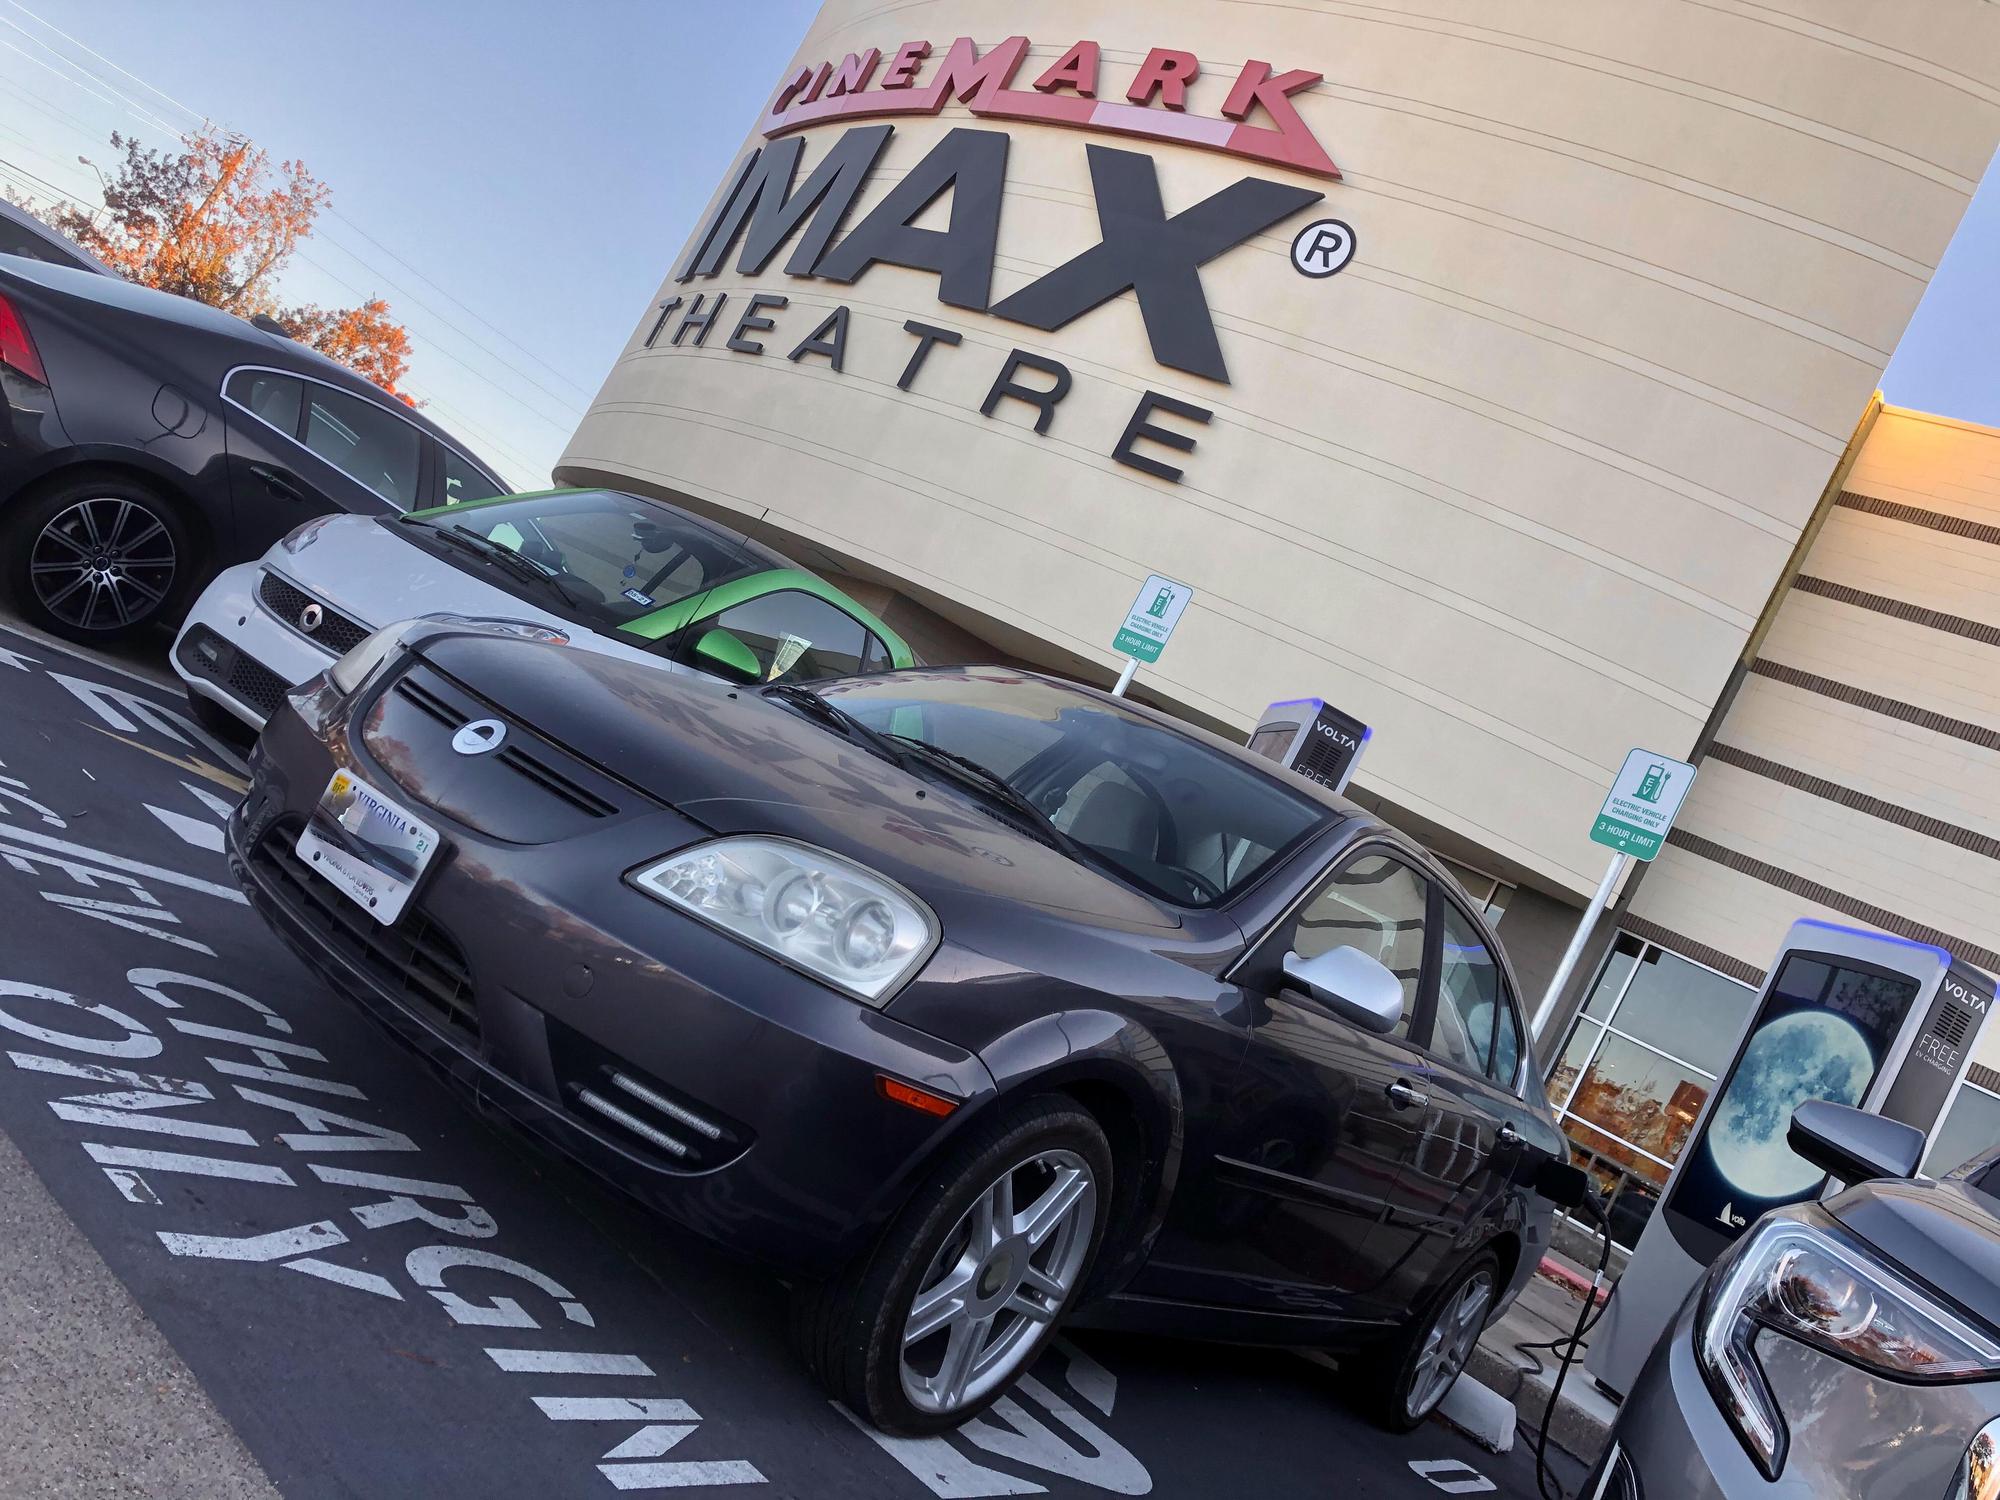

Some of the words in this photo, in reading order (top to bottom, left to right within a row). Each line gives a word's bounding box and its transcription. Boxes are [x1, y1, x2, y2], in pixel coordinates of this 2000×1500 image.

[761, 35, 1343, 180] CINEMARK
[675, 124, 1326, 385] IMAX
[644, 293, 1215, 485] THEATRE
[1154, 598, 1163, 612] EV
[1130, 622, 1152, 634] CHARGING
[1152, 630, 1163, 638] ONLY
[1131, 614, 1152, 627] ELECTRIC
[1152, 622, 1168, 633] VEHICLE
[1119, 633, 1125, 641] 3
[1125, 637, 1141, 646] HOUR
[1141, 642, 1158, 653] LIMIT
[1316, 720, 1356, 751] VOLTA
[1642, 777, 1655, 795] EV
[358, 791, 407, 834] VIRGINIA
[1612, 797, 1642, 813] ELECTRIC
[1642, 808, 1667, 821] VEHICLE
[1612, 806, 1643, 823] CHARGING
[1644, 818, 1660, 829] ONLY
[416, 840, 429, 853] 21
[1599, 822, 1606, 831] 3
[1607, 824, 1631, 838] HOUR
[1632, 833, 1655, 847] LIMIT
[1944, 979, 1987, 1014] VOLTA
[1915, 1050, 1923, 1058] EV
[1923, 1054, 1952, 1076] CHARGING
[1919, 1033, 1960, 1068] FREE
[0, 979, 405, 1301] ONLY
